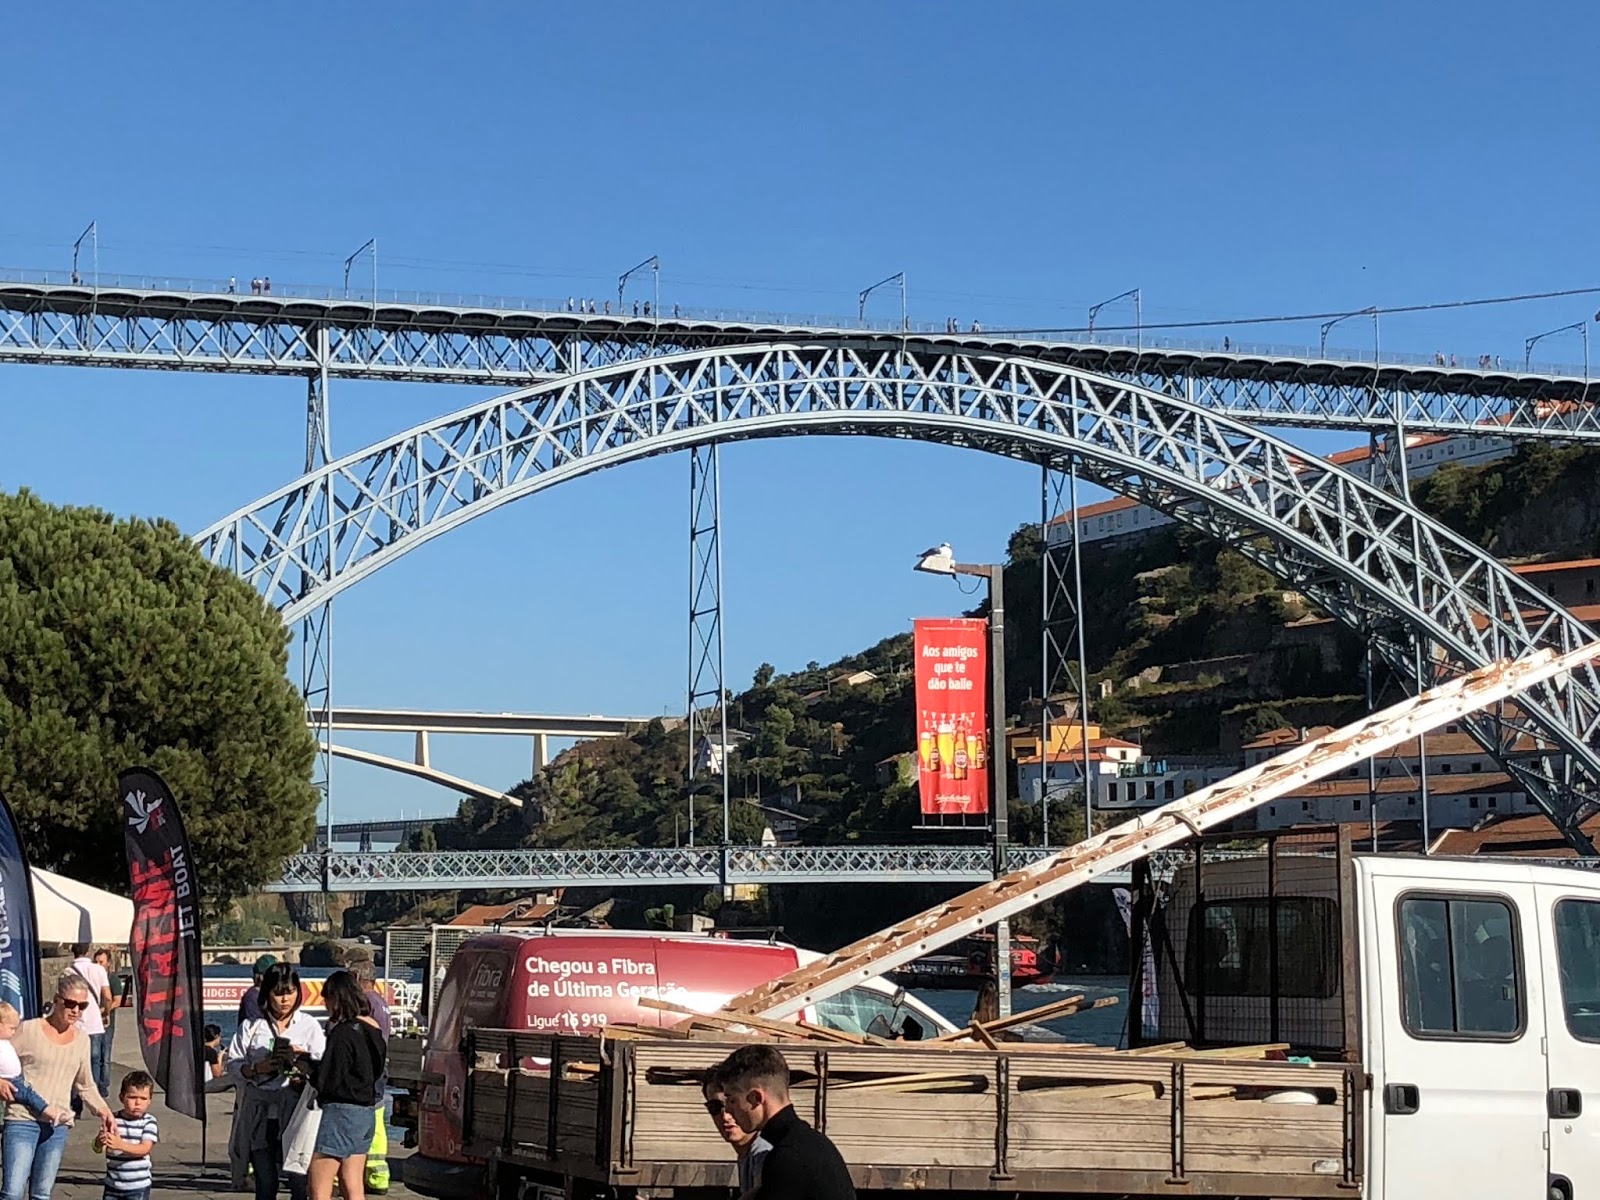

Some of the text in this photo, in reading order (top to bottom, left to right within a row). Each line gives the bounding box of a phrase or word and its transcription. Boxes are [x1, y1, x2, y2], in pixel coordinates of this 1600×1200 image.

[922, 645, 978, 661] Aos amigos
[934, 661, 965, 676] que te
[927, 677, 973, 690] dão baile
[170, 844, 195, 940] JET BOAT
[132, 851, 184, 1046] XTREME
[525, 957, 655, 977] Chegou a Fibra
[527, 981, 550, 997] de
[554, 977, 613, 997] Última
[527, 1012, 607, 1030] Ligue 16 919
